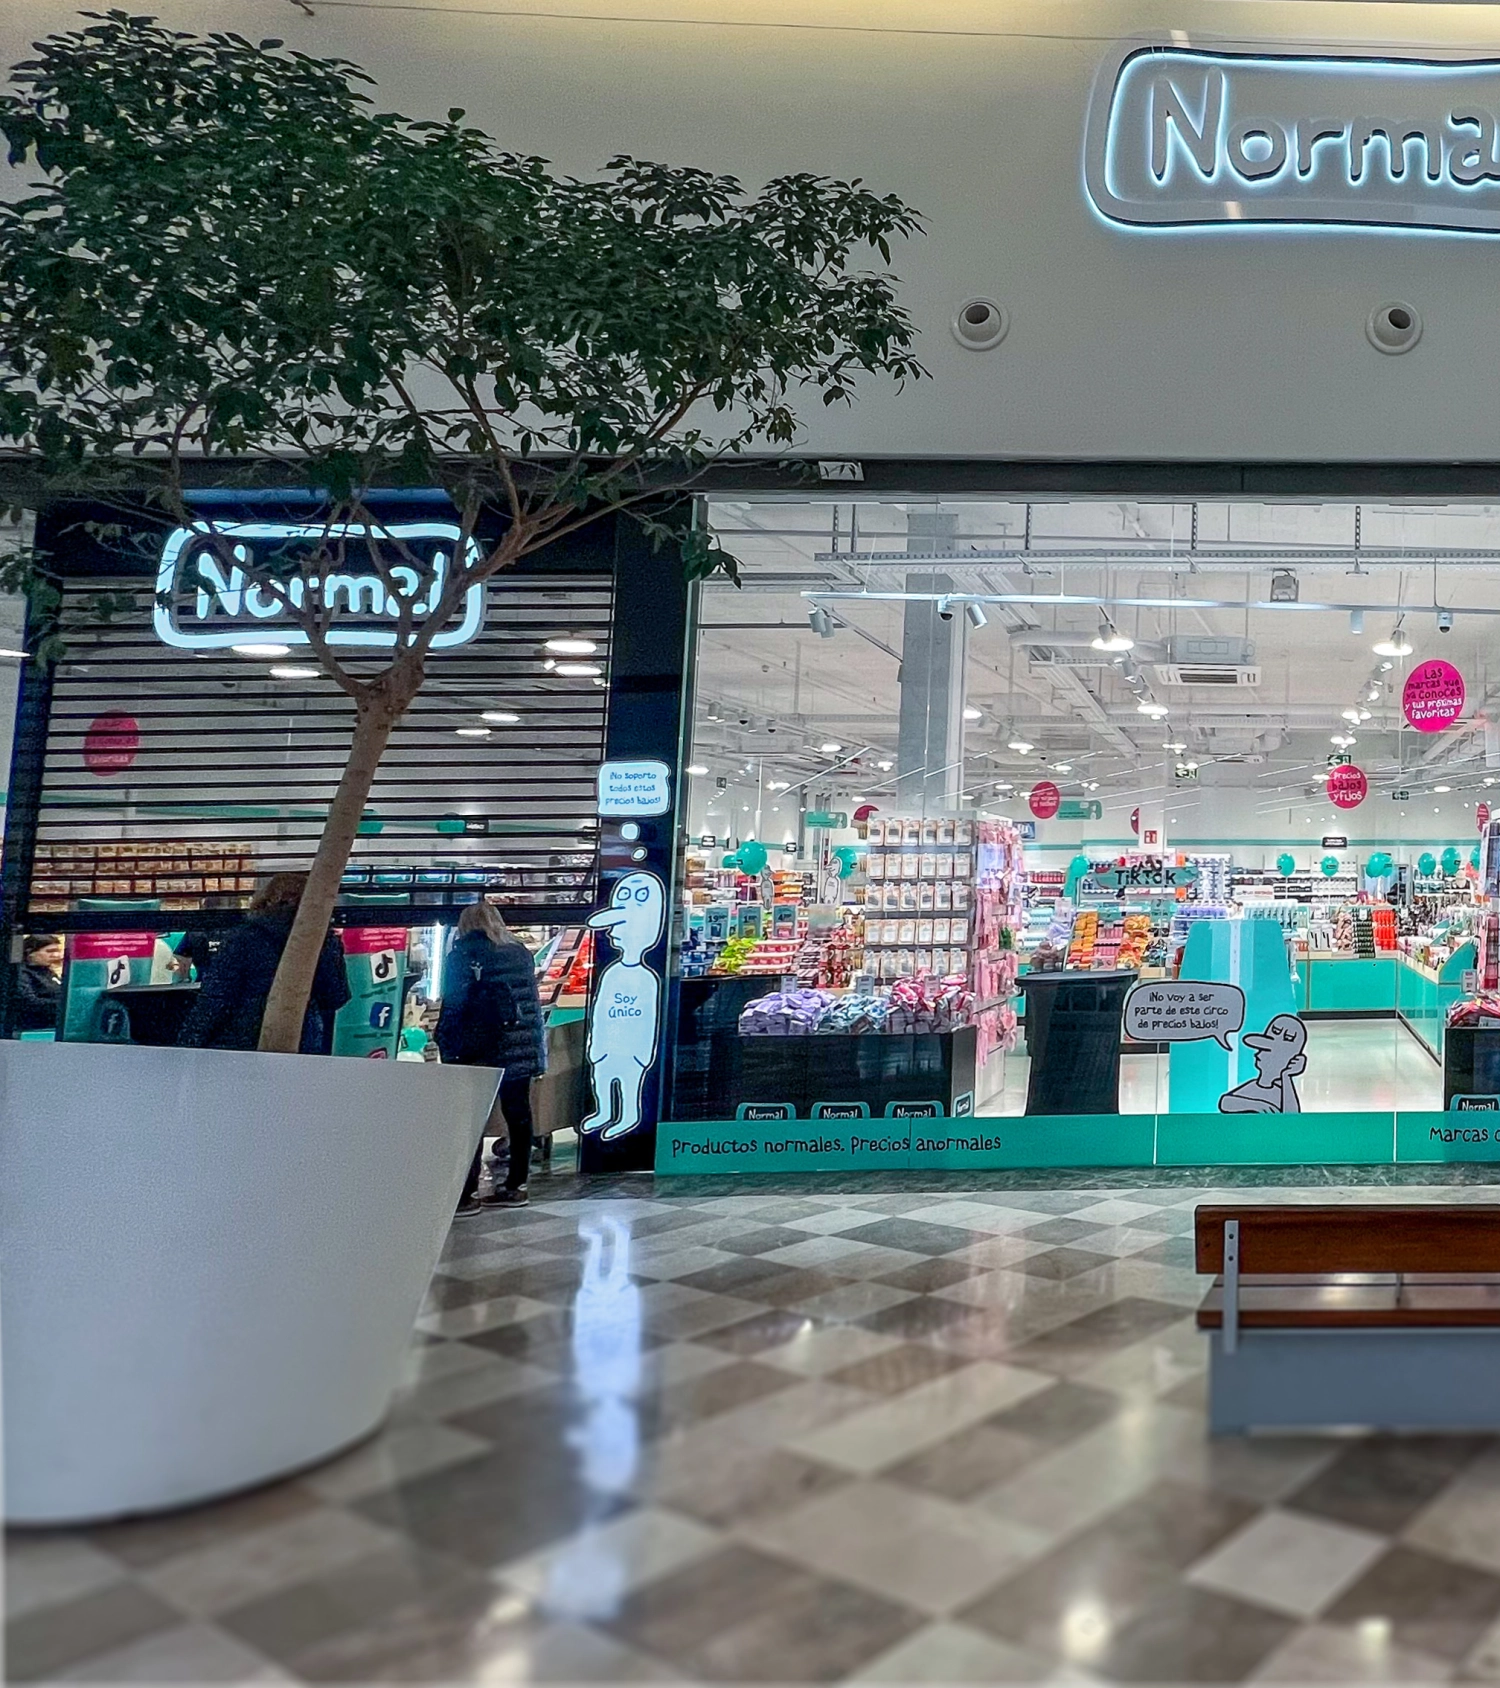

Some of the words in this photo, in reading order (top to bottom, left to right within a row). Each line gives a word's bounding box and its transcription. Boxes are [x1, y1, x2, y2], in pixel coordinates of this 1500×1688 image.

[1424, 668, 1443, 679] Las
[1407, 679, 1440, 690] marcas
[1444, 679, 1460, 688] que
[1405, 691, 1416, 701] ya
[1418, 686, 1462, 699] conoces
[1404, 703, 1410, 711] y
[1412, 701, 1425, 709] tus
[1411, 707, 1455, 719] favoritas
[625, 772, 657, 781] soporto
[609, 784, 631, 792] todos
[634, 784, 656, 792] estos
[1332, 780, 1362, 791] bajos
[605, 796, 635, 806] precios
[614, 992, 638, 1005] Soy
[1166, 993, 1185, 1003] voy
[1188, 993, 1195, 1002] a
[1198, 993, 1214, 1002] ser
[608, 1005, 642, 1018] único
[1134, 1006, 1162, 1017] parte
[1165, 1005, 1176, 1015] de
[1180, 1006, 1200, 1016] este
[1203, 1006, 1229, 1016] circo
[1137, 1019, 1148, 1029] de
[1152, 1019, 1187, 1031] precios
[1190, 1019, 1219, 1030] bajos!
[1461, 1100, 1495, 1111] Normal
[748, 1108, 784, 1119] Normal
[823, 1107, 858, 1119] Normal
[896, 1106, 932, 1118] Normal
[1429, 1127, 1489, 1143] Marcas
[764, 1136, 845, 1154] normales.
[915, 1134, 1002, 1151] anormales
